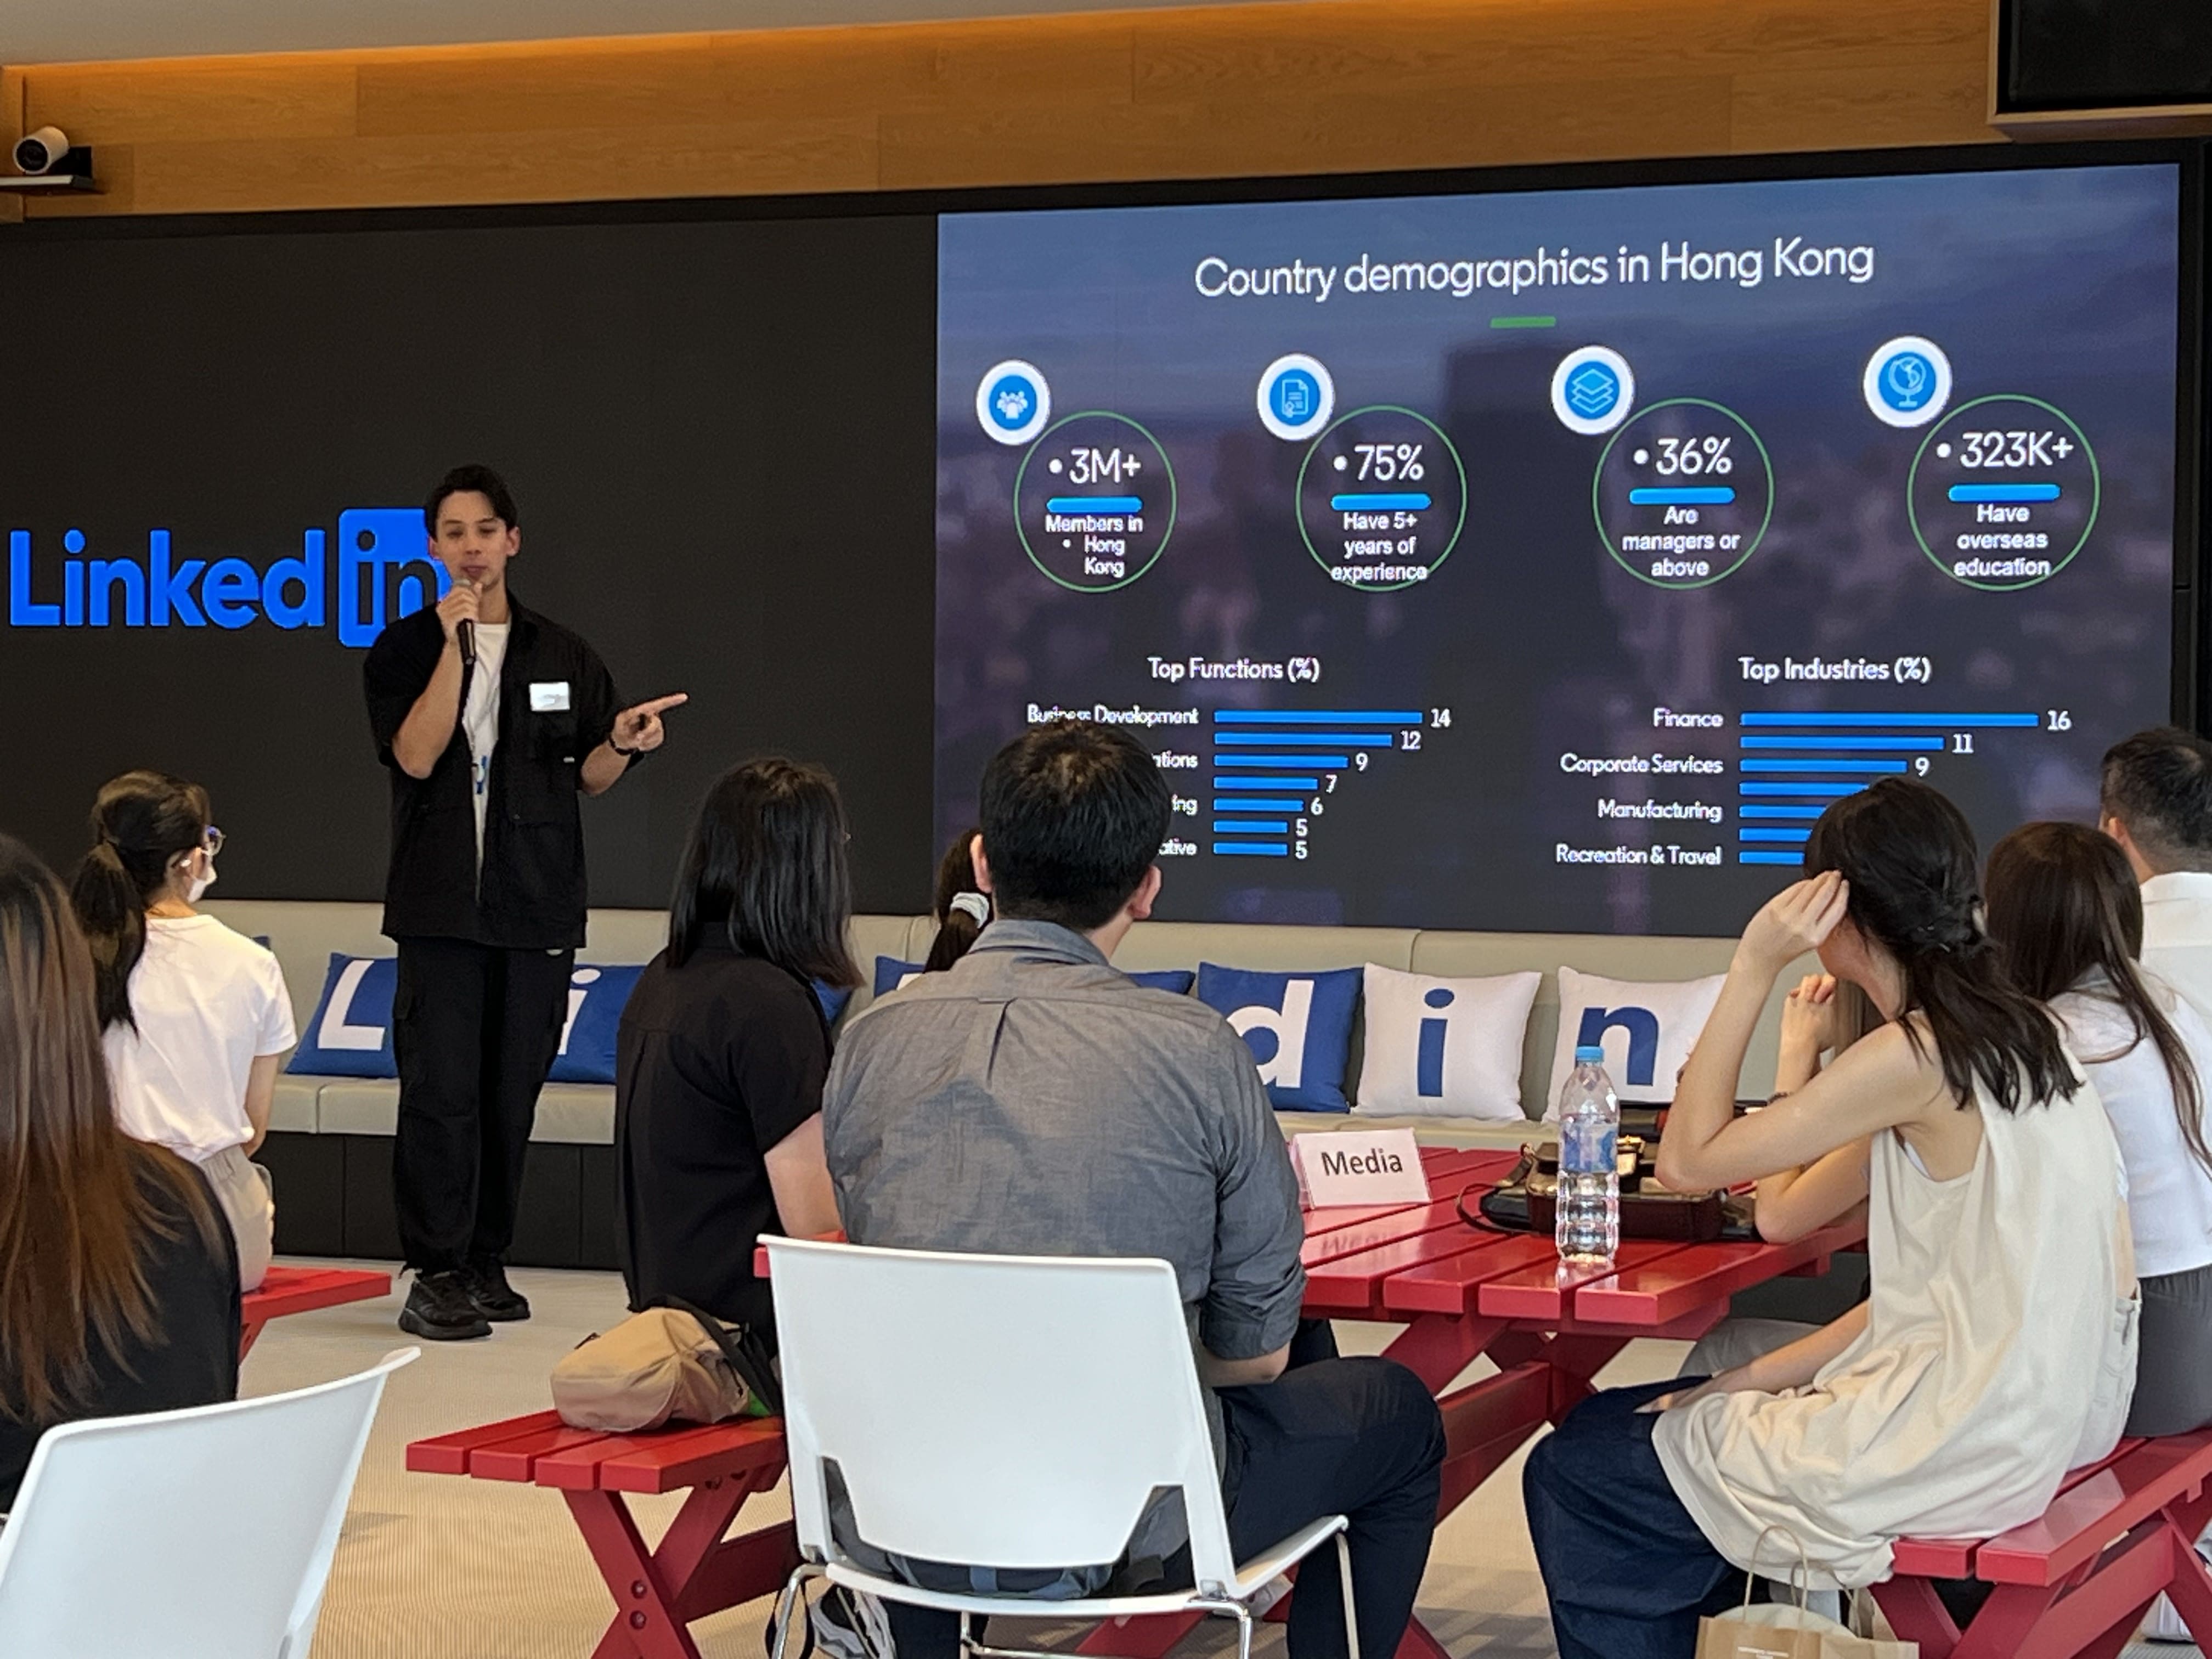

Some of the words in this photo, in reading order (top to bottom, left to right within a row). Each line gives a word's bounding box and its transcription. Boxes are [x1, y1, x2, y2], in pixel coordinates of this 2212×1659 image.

[1195, 256, 1337, 303] Country
[1344, 246, 1609, 297] demographics
[1617, 245, 1649, 283] in
[1661, 240, 1763, 287] Hong
[1774, 236, 1874, 284] Kong
[1655, 436, 1733, 475] 36%
[1960, 431, 2074, 468] 323K+
[1068, 447, 1142, 484] 3M+
[1353, 443, 1425, 481] 75%
[1045, 514, 1124, 533] Members
[1127, 515, 1143, 532] in
[1343, 511, 1390, 531] Have
[1392, 511, 1418, 530] 5+
[1663, 505, 1699, 525] Are
[1976, 504, 2030, 523] Have
[1084, 534, 1125, 557] Hong
[1344, 540, 1394, 560] years
[1396, 535, 1417, 555] of
[1622, 534, 1716, 554] managers
[1719, 534, 1742, 550] or
[1956, 533, 2049, 550] overseas
[1084, 557, 1125, 579] Kong
[1330, 562, 1429, 585] experience
[1651, 557, 1710, 577] above
[1953, 557, 2050, 577] education
[1147, 657, 1185, 683] Top
[1189, 656, 1284, 680] Functions
[1287, 657, 1320, 683] (%)
[1737, 656, 1781, 684] Top
[1784, 657, 1891, 680] Industries
[1893, 656, 1932, 684] (%)
[1094, 704, 1199, 728] Development
[1430, 708, 1452, 728] 14
[1653, 707, 1724, 727] Finance
[2047, 709, 2072, 731] 16
[1400, 730, 1421, 750] 12
[1951, 733, 1974, 754] 11
[1355, 752, 1369, 772] 9
[1560, 752, 1650, 777] Corporate
[1651, 752, 1724, 774] Services
[1915, 757, 1930, 777] 9
[1325, 774, 1338, 794] 7
[1310, 797, 1324, 816] 6
[1597, 798, 1723, 823] Manufacturing
[1295, 818, 1308, 837] 5
[1295, 840, 1308, 860] 5
[1556, 843, 1648, 864] Recreation
[1650, 844, 1665, 865] &
[1667, 845, 1722, 866] Travel
[317, 960, 385, 1051] L
[1417, 988, 1455, 1097] i
[1321, 1148, 1403, 1176] Media
